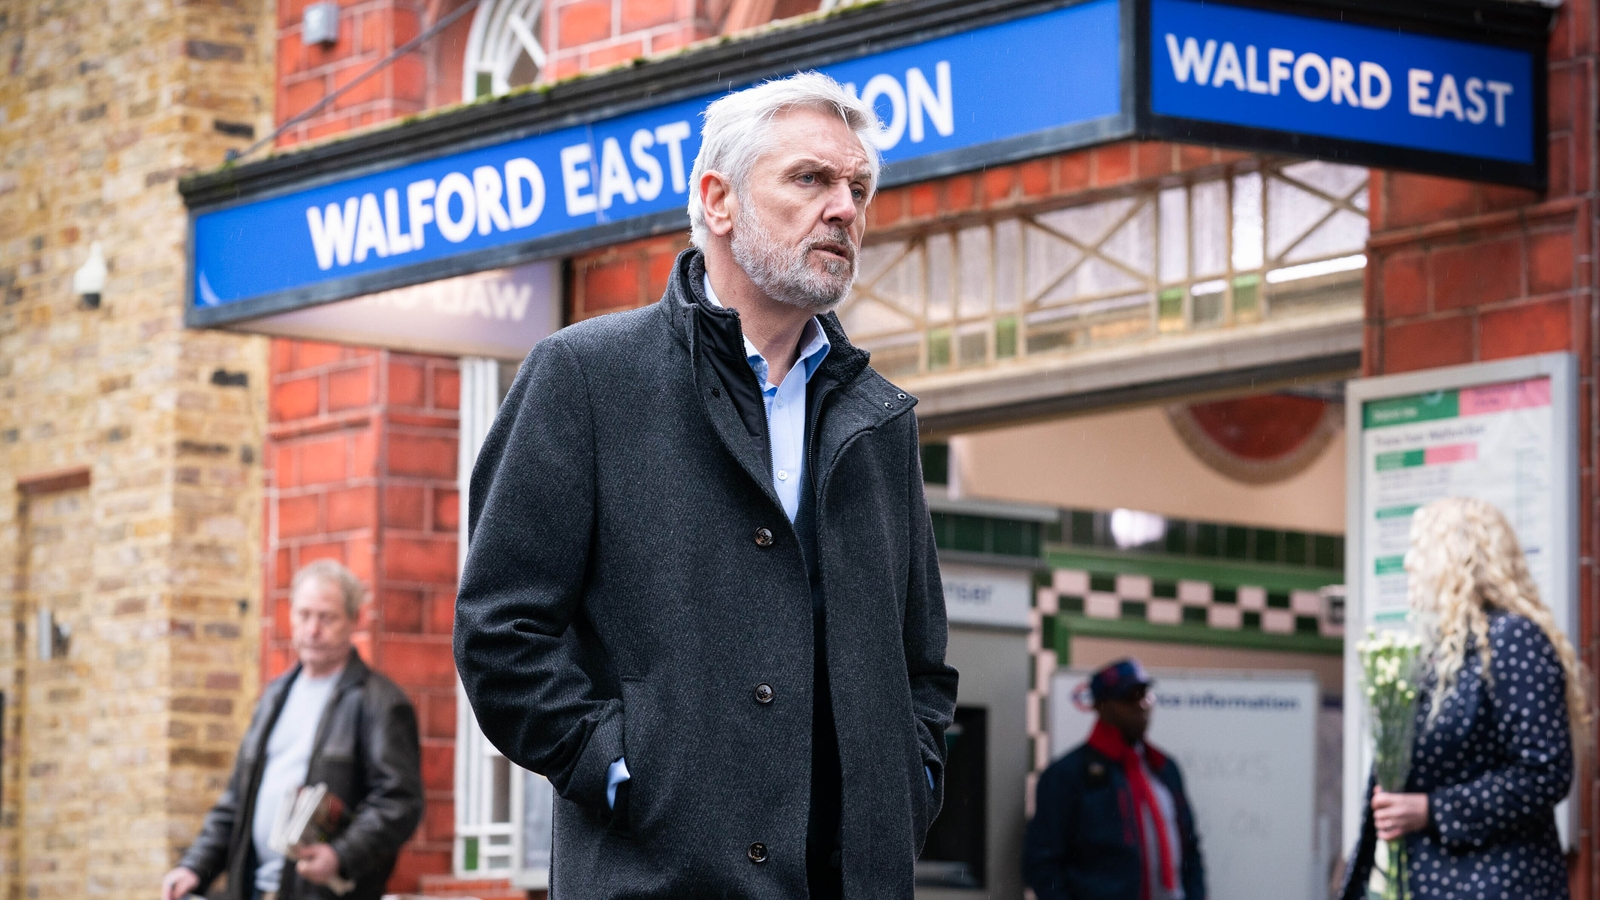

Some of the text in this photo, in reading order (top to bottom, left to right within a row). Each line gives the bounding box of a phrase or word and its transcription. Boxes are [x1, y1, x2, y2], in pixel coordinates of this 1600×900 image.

[1165, 33, 1513, 126] WALFORD EAST
[306, 119, 691, 270] WALFORD EAST
[1190, 691, 1300, 711] information
